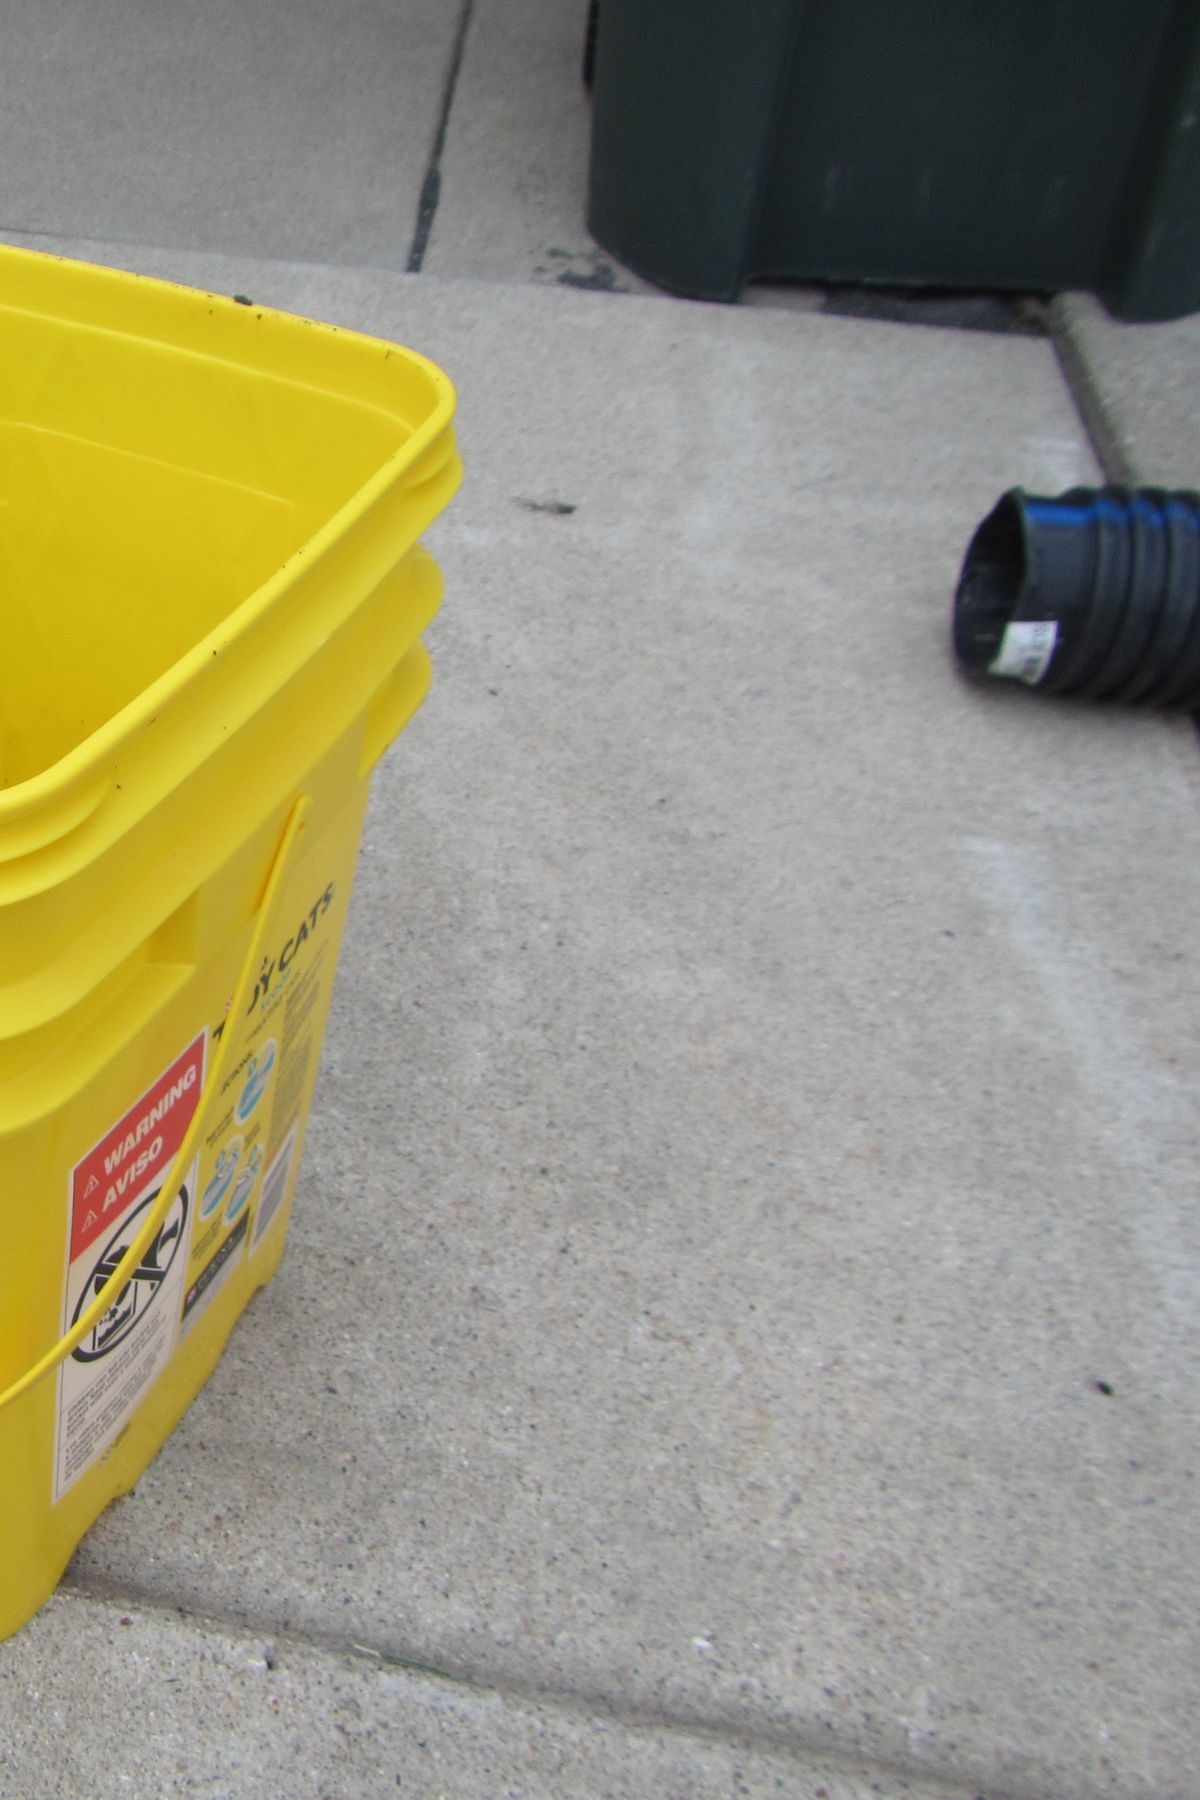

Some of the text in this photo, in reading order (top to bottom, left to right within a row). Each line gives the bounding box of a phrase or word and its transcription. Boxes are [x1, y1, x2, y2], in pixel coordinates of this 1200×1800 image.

[278, 881, 334, 972] CATS
[104, 1064, 196, 1175] WARNING
[102, 1135, 163, 1212] AVISO
